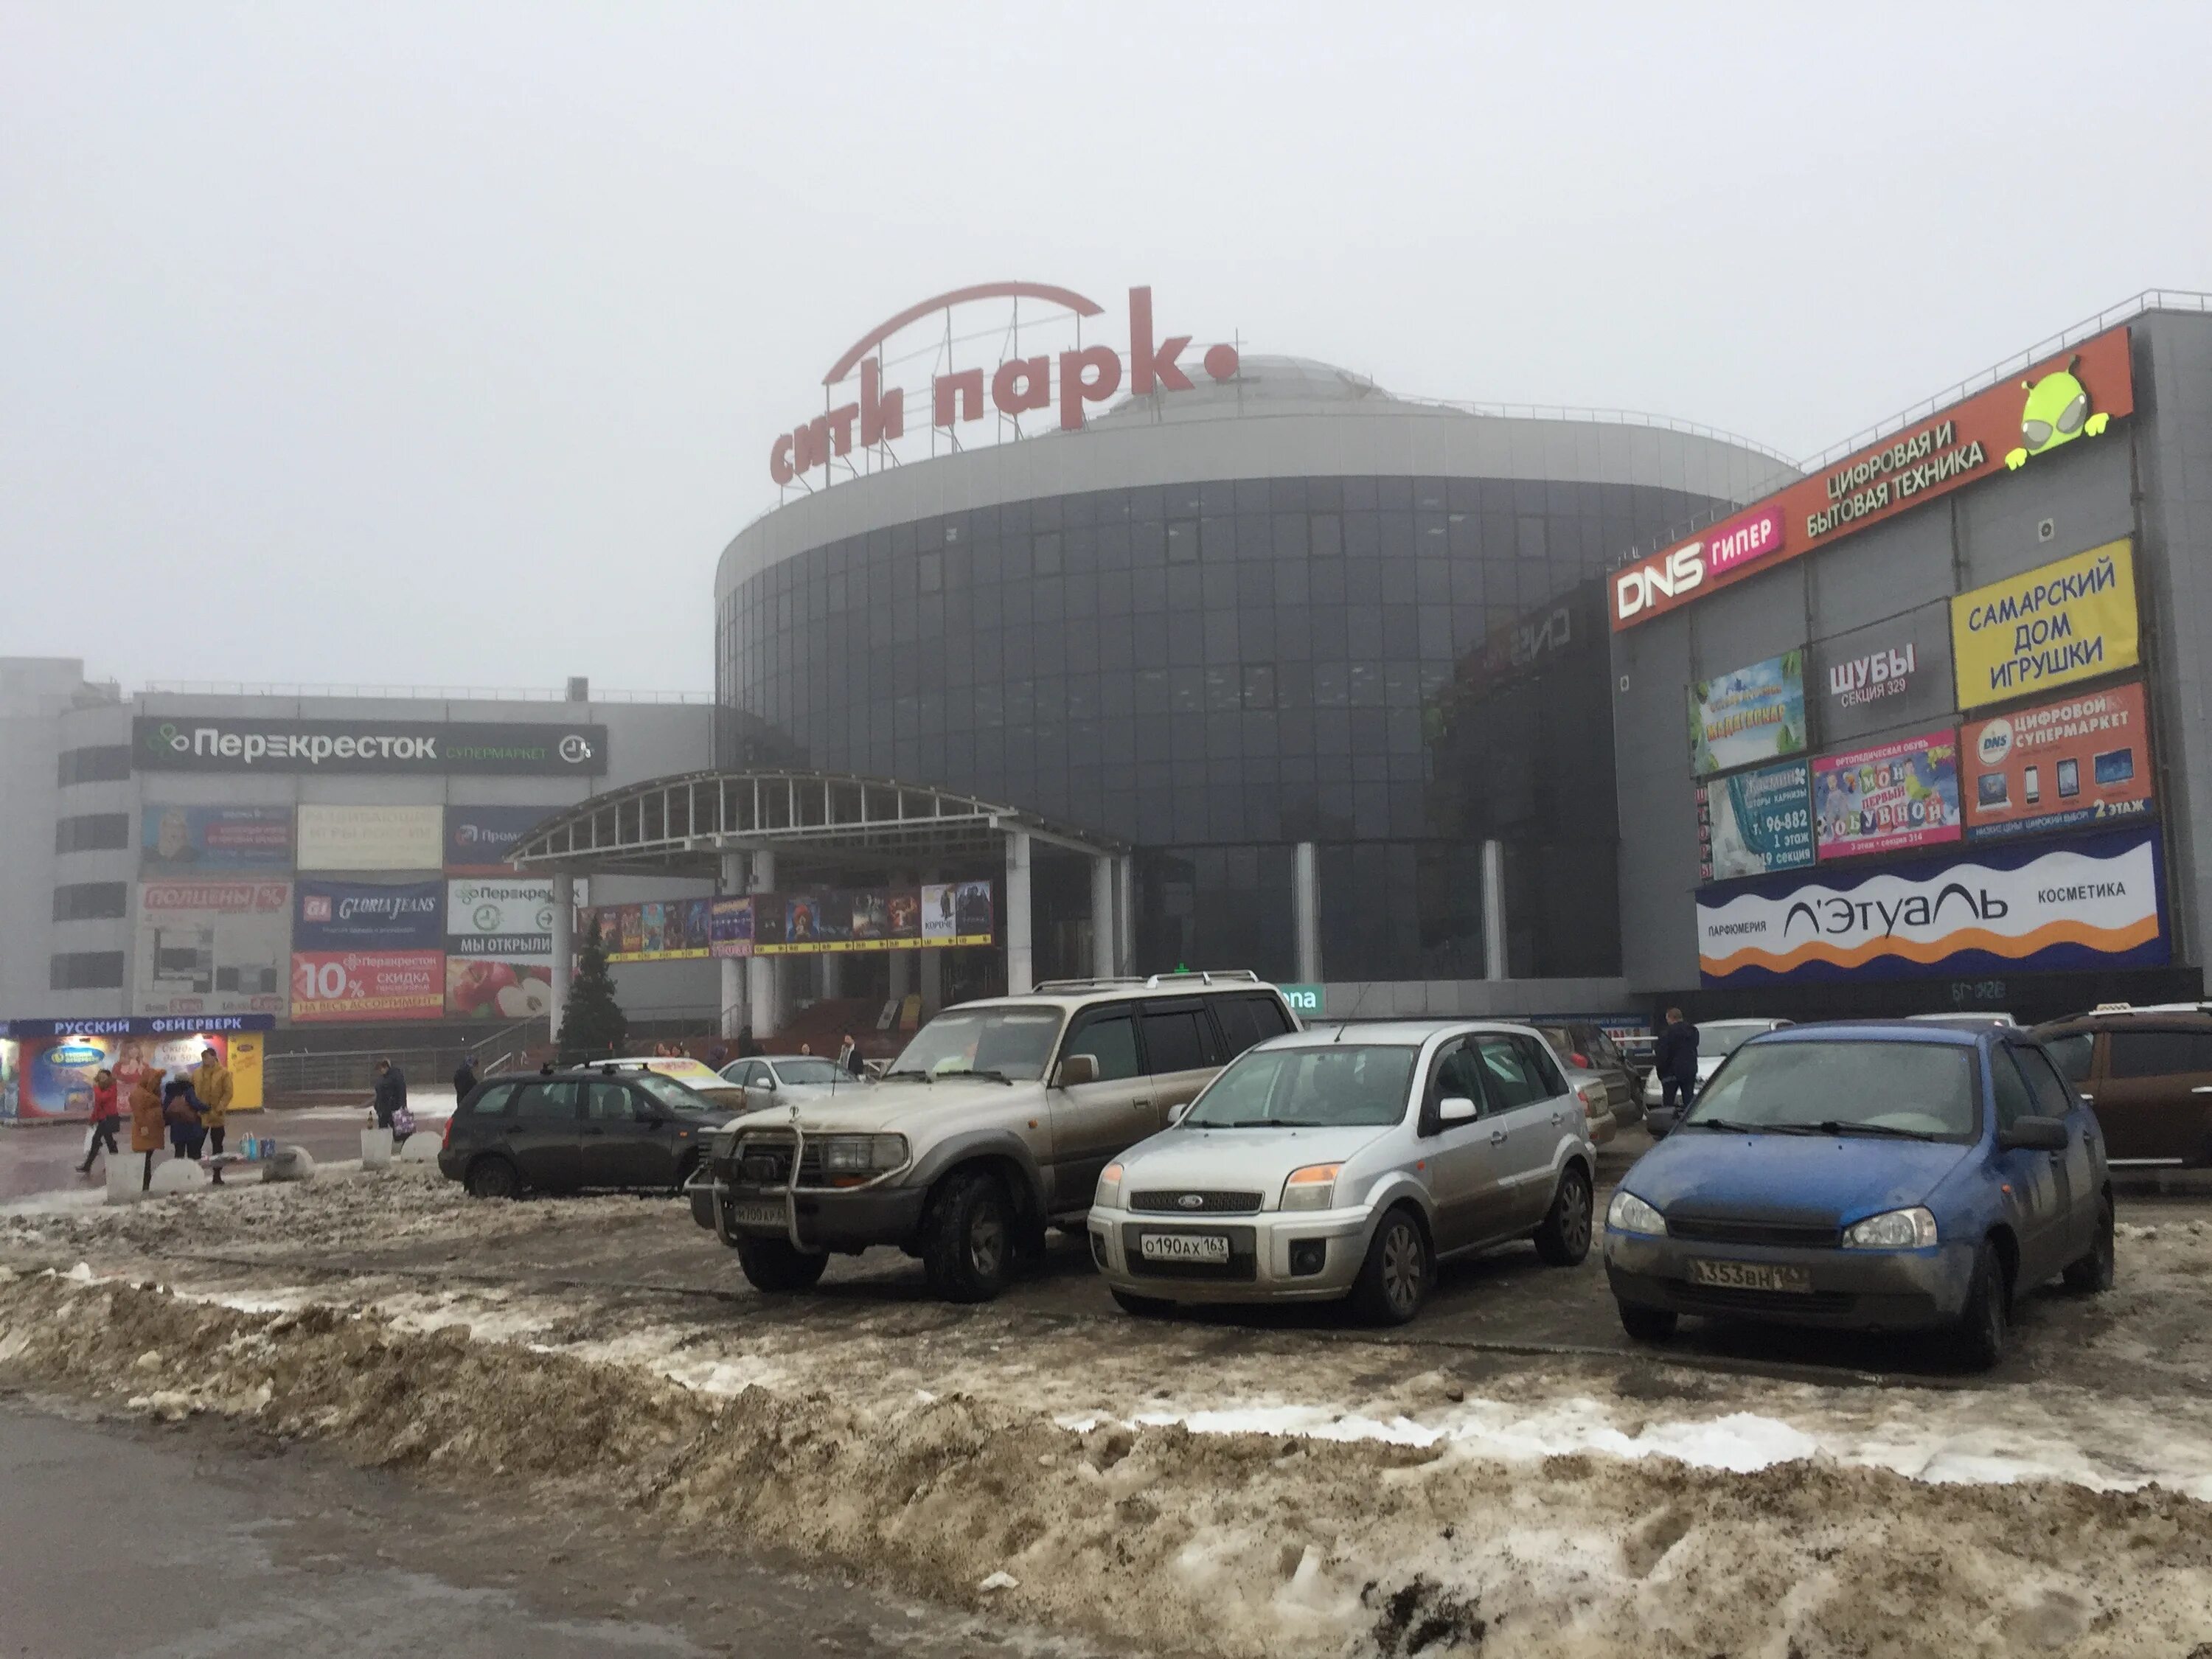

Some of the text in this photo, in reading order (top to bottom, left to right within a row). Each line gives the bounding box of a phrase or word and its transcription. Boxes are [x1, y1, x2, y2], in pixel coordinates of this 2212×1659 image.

[1827, 420, 1953, 500] ЦИФРОВАЯ И
[1806, 440, 1984, 538] БЫТОВАЯ ТЕХНИКА
[1711, 518, 1772, 566] ГИПЕР
[1617, 542, 1705, 620] DNS
[1968, 556, 2116, 632] САМАРСКИЙ
[2014, 611, 2072, 655] ДОМ
[1829, 642, 1916, 696] ШУБЫ
[1990, 635, 2103, 690] ИГРУШКИ
[1841, 678, 1906, 709] СЕКЦИЯ 329
[2014, 695, 2106, 732] ЦИФРОВОЙ
[1983, 734, 2007, 750] DNS
[2015, 710, 2129, 748] СУПЕРМАРКЕТ
[195, 728, 547, 764] Перекресток СУПЕРМАРКЕТ
[1835, 739, 1929, 768] ОРТОПЕДИЧЕСКАЯ ОБУВЬ
[1774, 788, 1807, 803] КАРНИЗЫ
[1862, 785, 1906, 809] ПЕРВЫЙ
[2093, 799, 2146, 818] 2 ЭТАЖ
[1766, 809, 1808, 833] 96-882
[1834, 799, 1941, 835] ОБУВНОЙ
[1775, 832, 1809, 848] 1 этаж
[1775, 848, 1811, 864] секция
[2037, 881, 2127, 905] КОСМЕТИКА
[1708, 919, 1767, 937] ПАРФЮМЕРИЯ
[460, 938, 552, 952] МЫ ОТКРЫЛИ
[377, 971, 430, 985] СКИДКА
[299, 1002, 316, 1012] НА
[54, 1017, 242, 1034] РУССКИЙ ФЕЙЕРВЕРК
[1145, 1237, 1225, 1255] О190АХ 163
